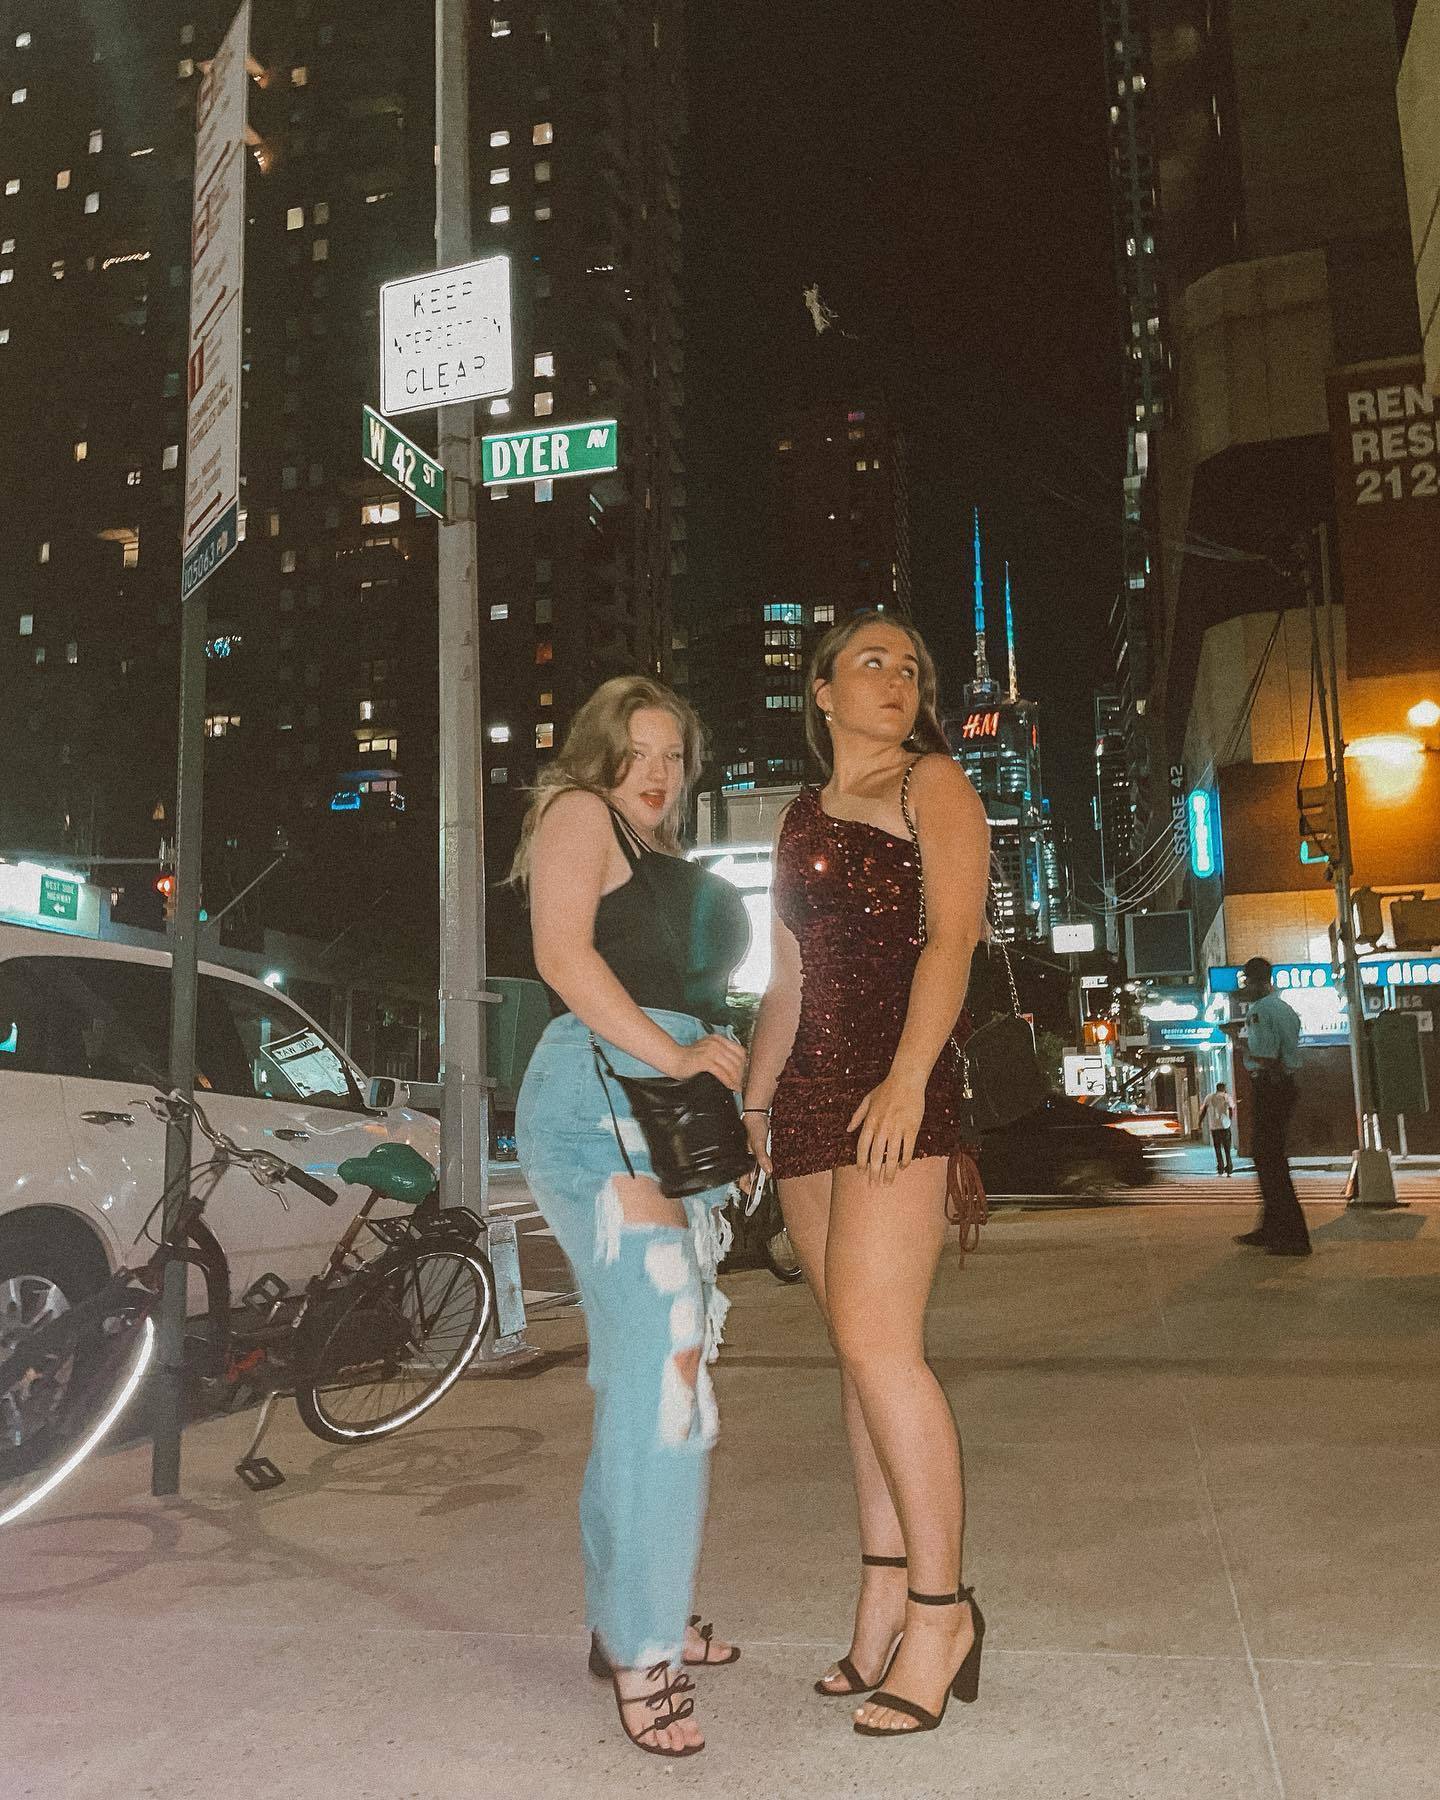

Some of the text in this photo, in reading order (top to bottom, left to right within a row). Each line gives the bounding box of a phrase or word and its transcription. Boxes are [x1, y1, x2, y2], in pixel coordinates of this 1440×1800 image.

[414, 281, 472, 317] KEEP
[406, 355, 486, 394] CLEAR
[1348, 385, 1434, 424] REN
[369, 416, 437, 492] W 42 ST
[490, 428, 609, 478] DYER AV
[1356, 462, 1439, 505] 212
[962, 711, 1000, 738] H&M
[1170, 764, 1189, 856] STAGE 42
